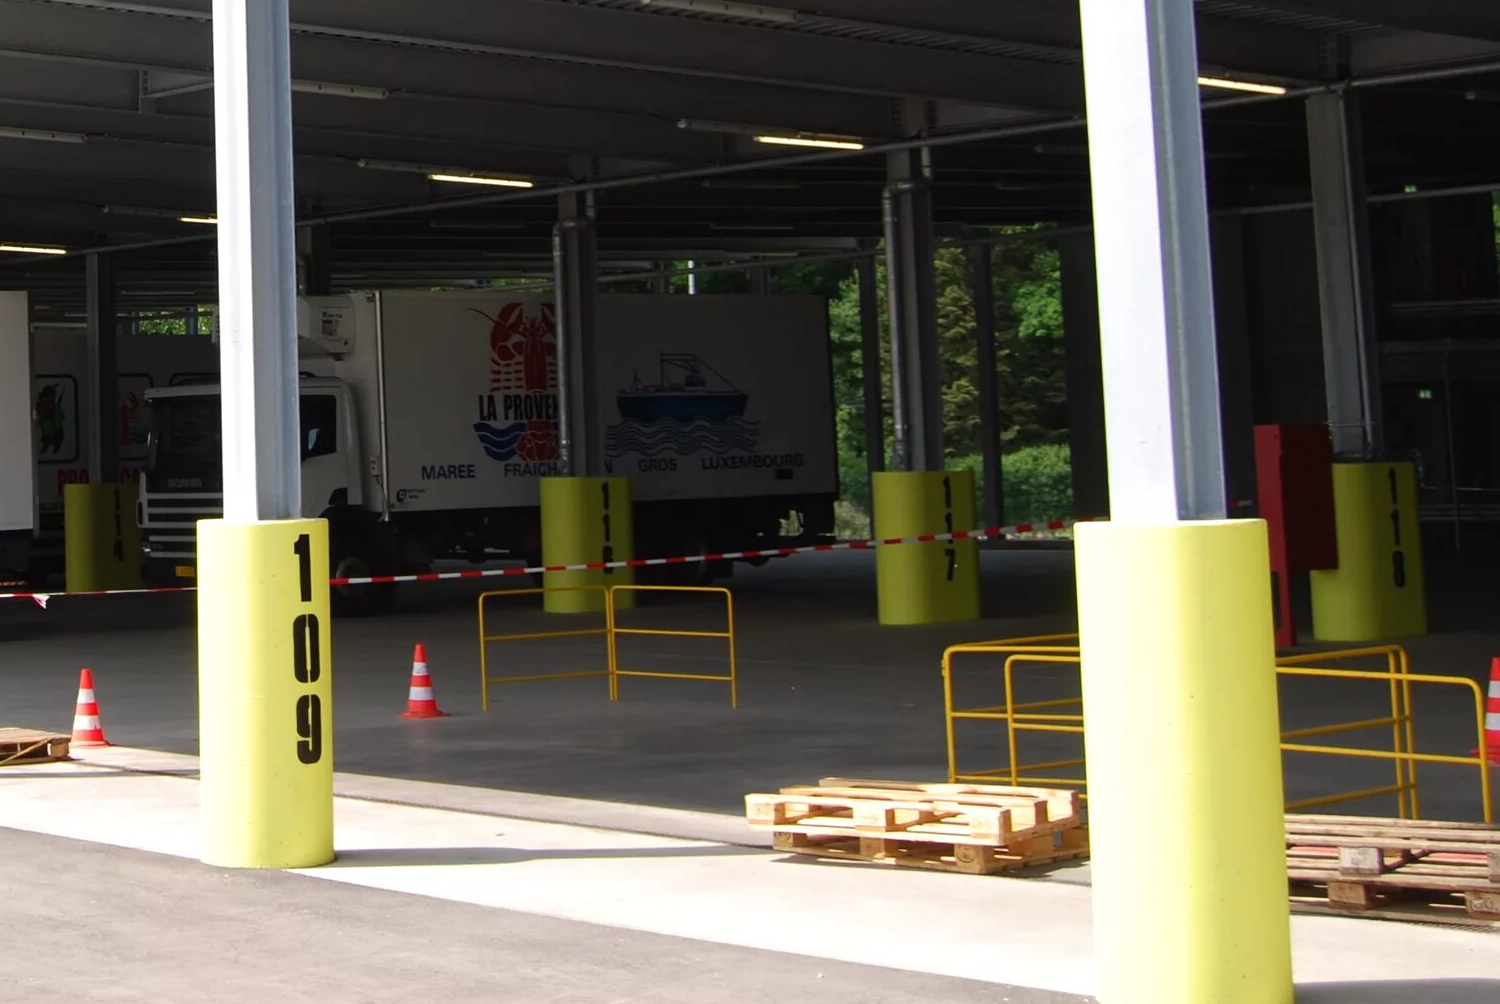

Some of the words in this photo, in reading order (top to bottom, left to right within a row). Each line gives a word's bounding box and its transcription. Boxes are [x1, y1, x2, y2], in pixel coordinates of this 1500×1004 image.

[478, 394, 497, 421] LA
[421, 464, 476, 480] MAREE
[504, 462, 558, 477] FRAICH
[638, 457, 678, 472] GROS
[702, 453, 805, 470] LUXEMBOURG
[943, 476, 955, 581] 117
[293, 533, 321, 764] 109
